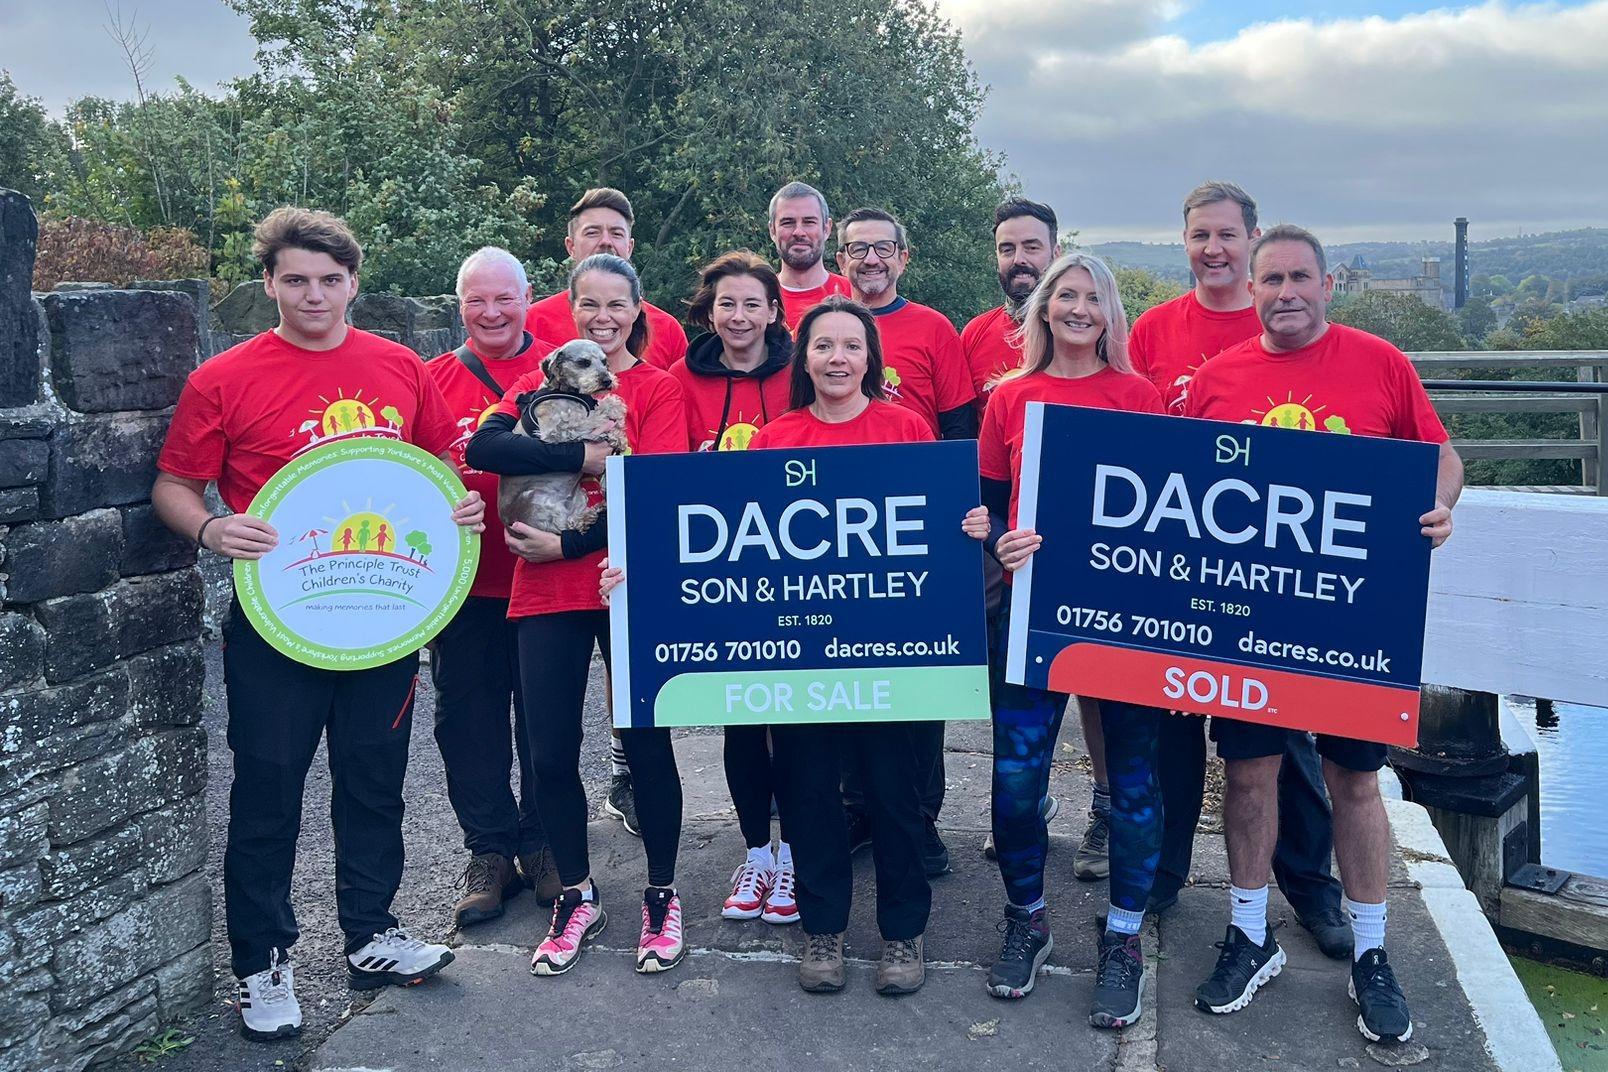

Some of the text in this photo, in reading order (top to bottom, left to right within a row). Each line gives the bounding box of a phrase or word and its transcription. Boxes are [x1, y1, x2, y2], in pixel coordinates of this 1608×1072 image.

[341, 446, 386, 456] Supporting
[387, 447, 427, 467] Yorkshire's
[427, 464, 444, 481] Most
[1091, 463, 1372, 560] DACRE
[677, 495, 929, 563] DACRE
[244, 562, 257, 596] Children
[298, 557, 421, 578] The Principle Trust
[1089, 542, 1366, 604] SON & HARTLEY
[301, 572, 413, 595] Children's Charity
[681, 571, 929, 605] SON & HARTLEY
[251, 597, 277, 634] Vulnerable
[305, 603, 406, 612] making memories that last
[1191, 598, 1251, 617] EST. 1820
[778, 614, 832, 626] EST. 1820
[276, 631, 296, 648] Most
[655, 634, 960, 663] 01756 701010 dacres.co.uk
[1057, 604, 1391, 673] 01756 701010 dacres.co.uk
[297, 643, 338, 662] Yorkshire's
[340, 649, 385, 662] Supporting
[725, 680, 892, 713] FOR SALE
[1162, 666, 1269, 711] SOLD
